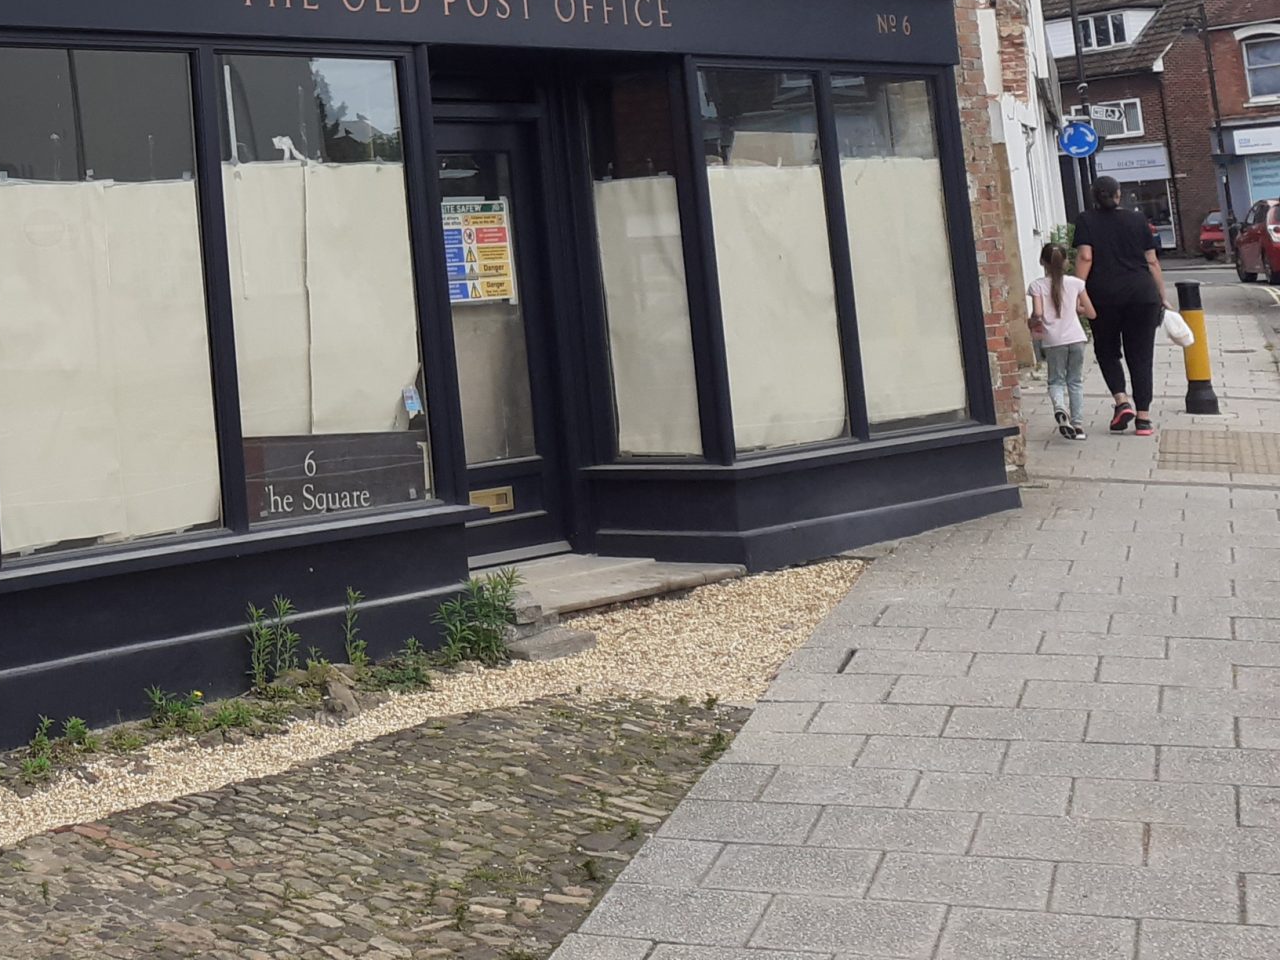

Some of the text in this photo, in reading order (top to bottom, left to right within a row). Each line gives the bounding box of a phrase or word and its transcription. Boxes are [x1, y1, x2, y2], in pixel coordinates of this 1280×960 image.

[902, 15, 911, 35] 6
[483, 264, 504, 272] Danger
[304, 450, 317, 477] 6
[265, 483, 371, 514] he Square
